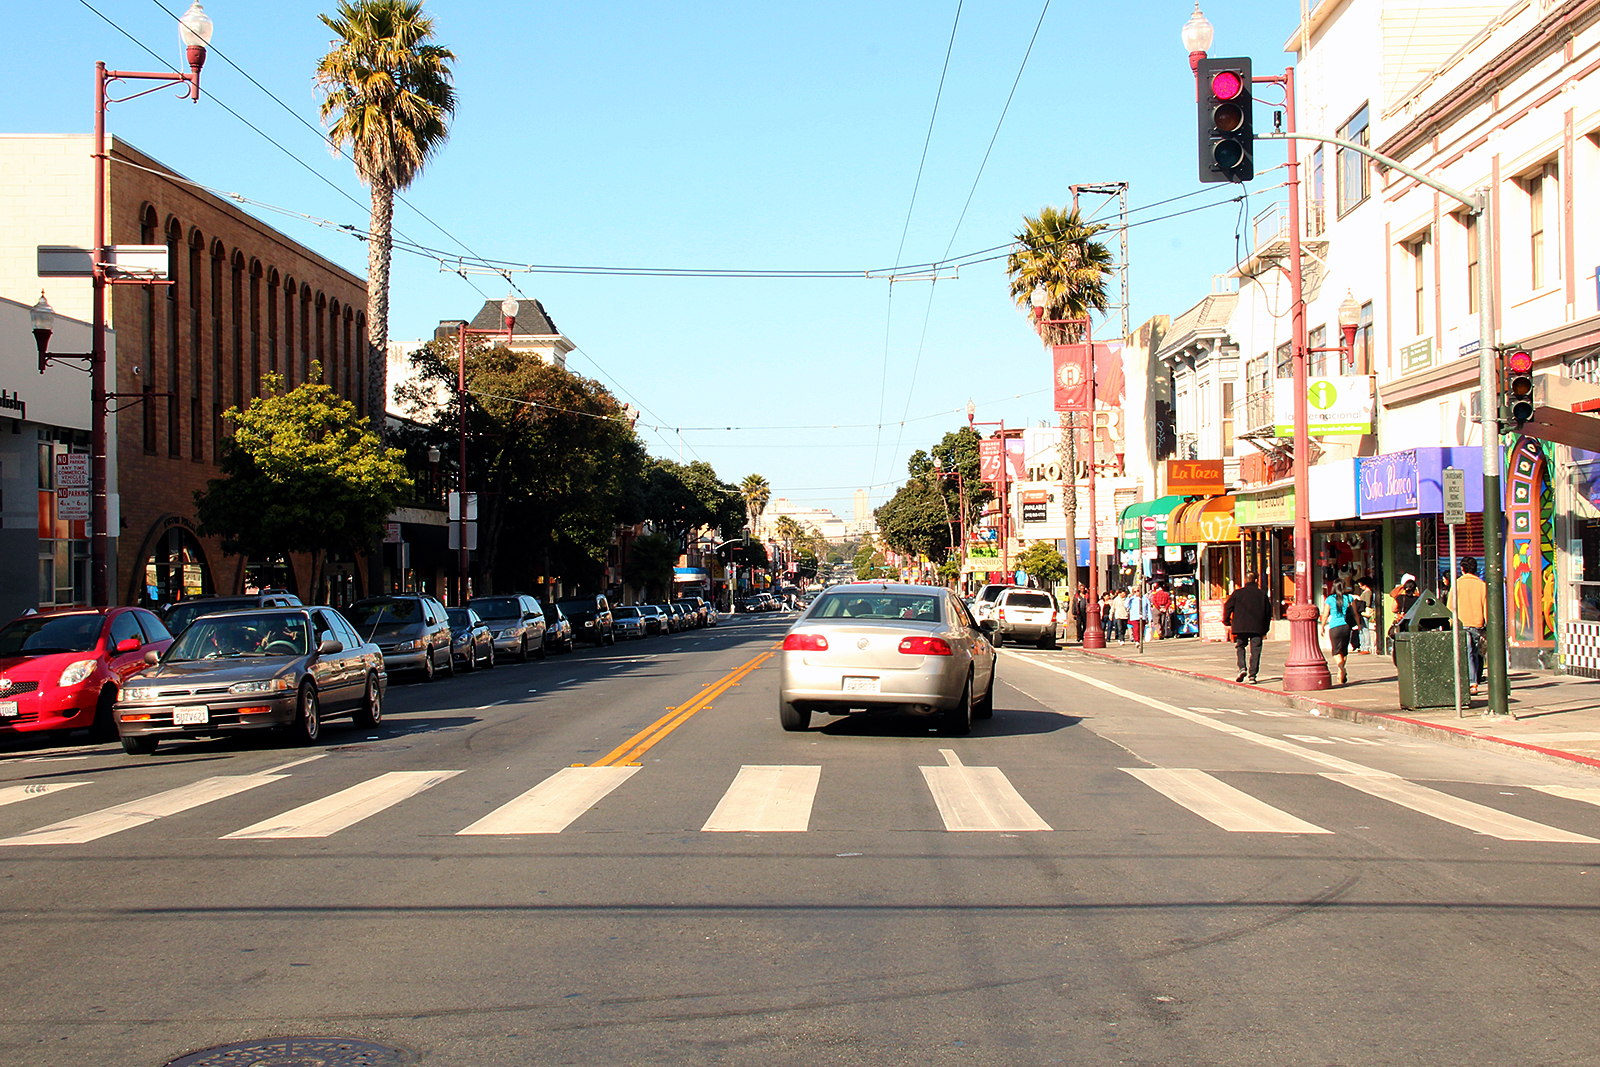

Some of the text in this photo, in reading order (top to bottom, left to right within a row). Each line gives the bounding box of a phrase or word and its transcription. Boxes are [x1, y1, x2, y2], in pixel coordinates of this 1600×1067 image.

[57, 455, 67, 464] NO
[981, 455, 1001, 469] 75
[1171, 463, 1219, 479] La Taza
[1385, 462, 1412, 496] Blanco
[58, 488, 67, 497] NO
